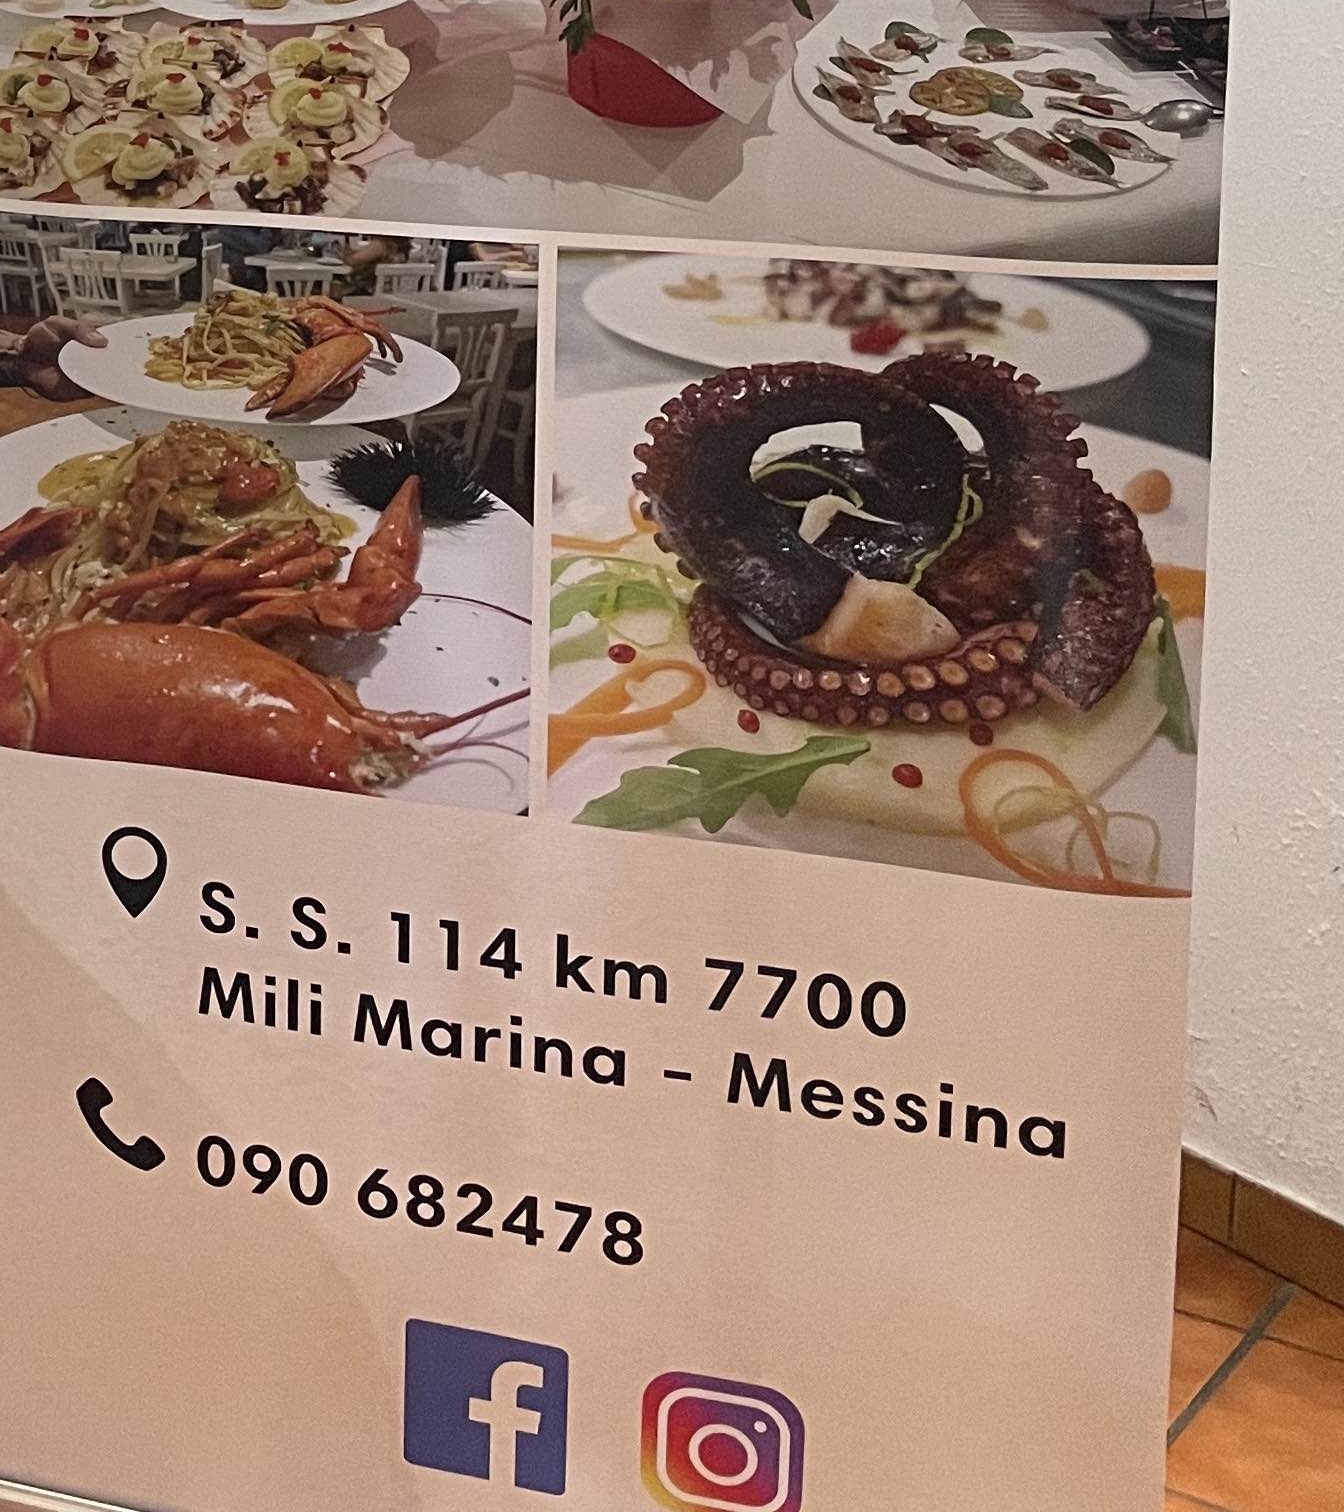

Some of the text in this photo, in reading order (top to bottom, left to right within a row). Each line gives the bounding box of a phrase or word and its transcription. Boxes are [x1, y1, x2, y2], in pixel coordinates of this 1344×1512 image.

[199, 881, 906, 1038] S. S. 114 km 7700
[198, 966, 322, 1036] Mili
[353, 993, 626, 1087] Marina
[727, 1052, 1066, 1159] Messina
[197, 1135, 644, 1266] 090 682478
